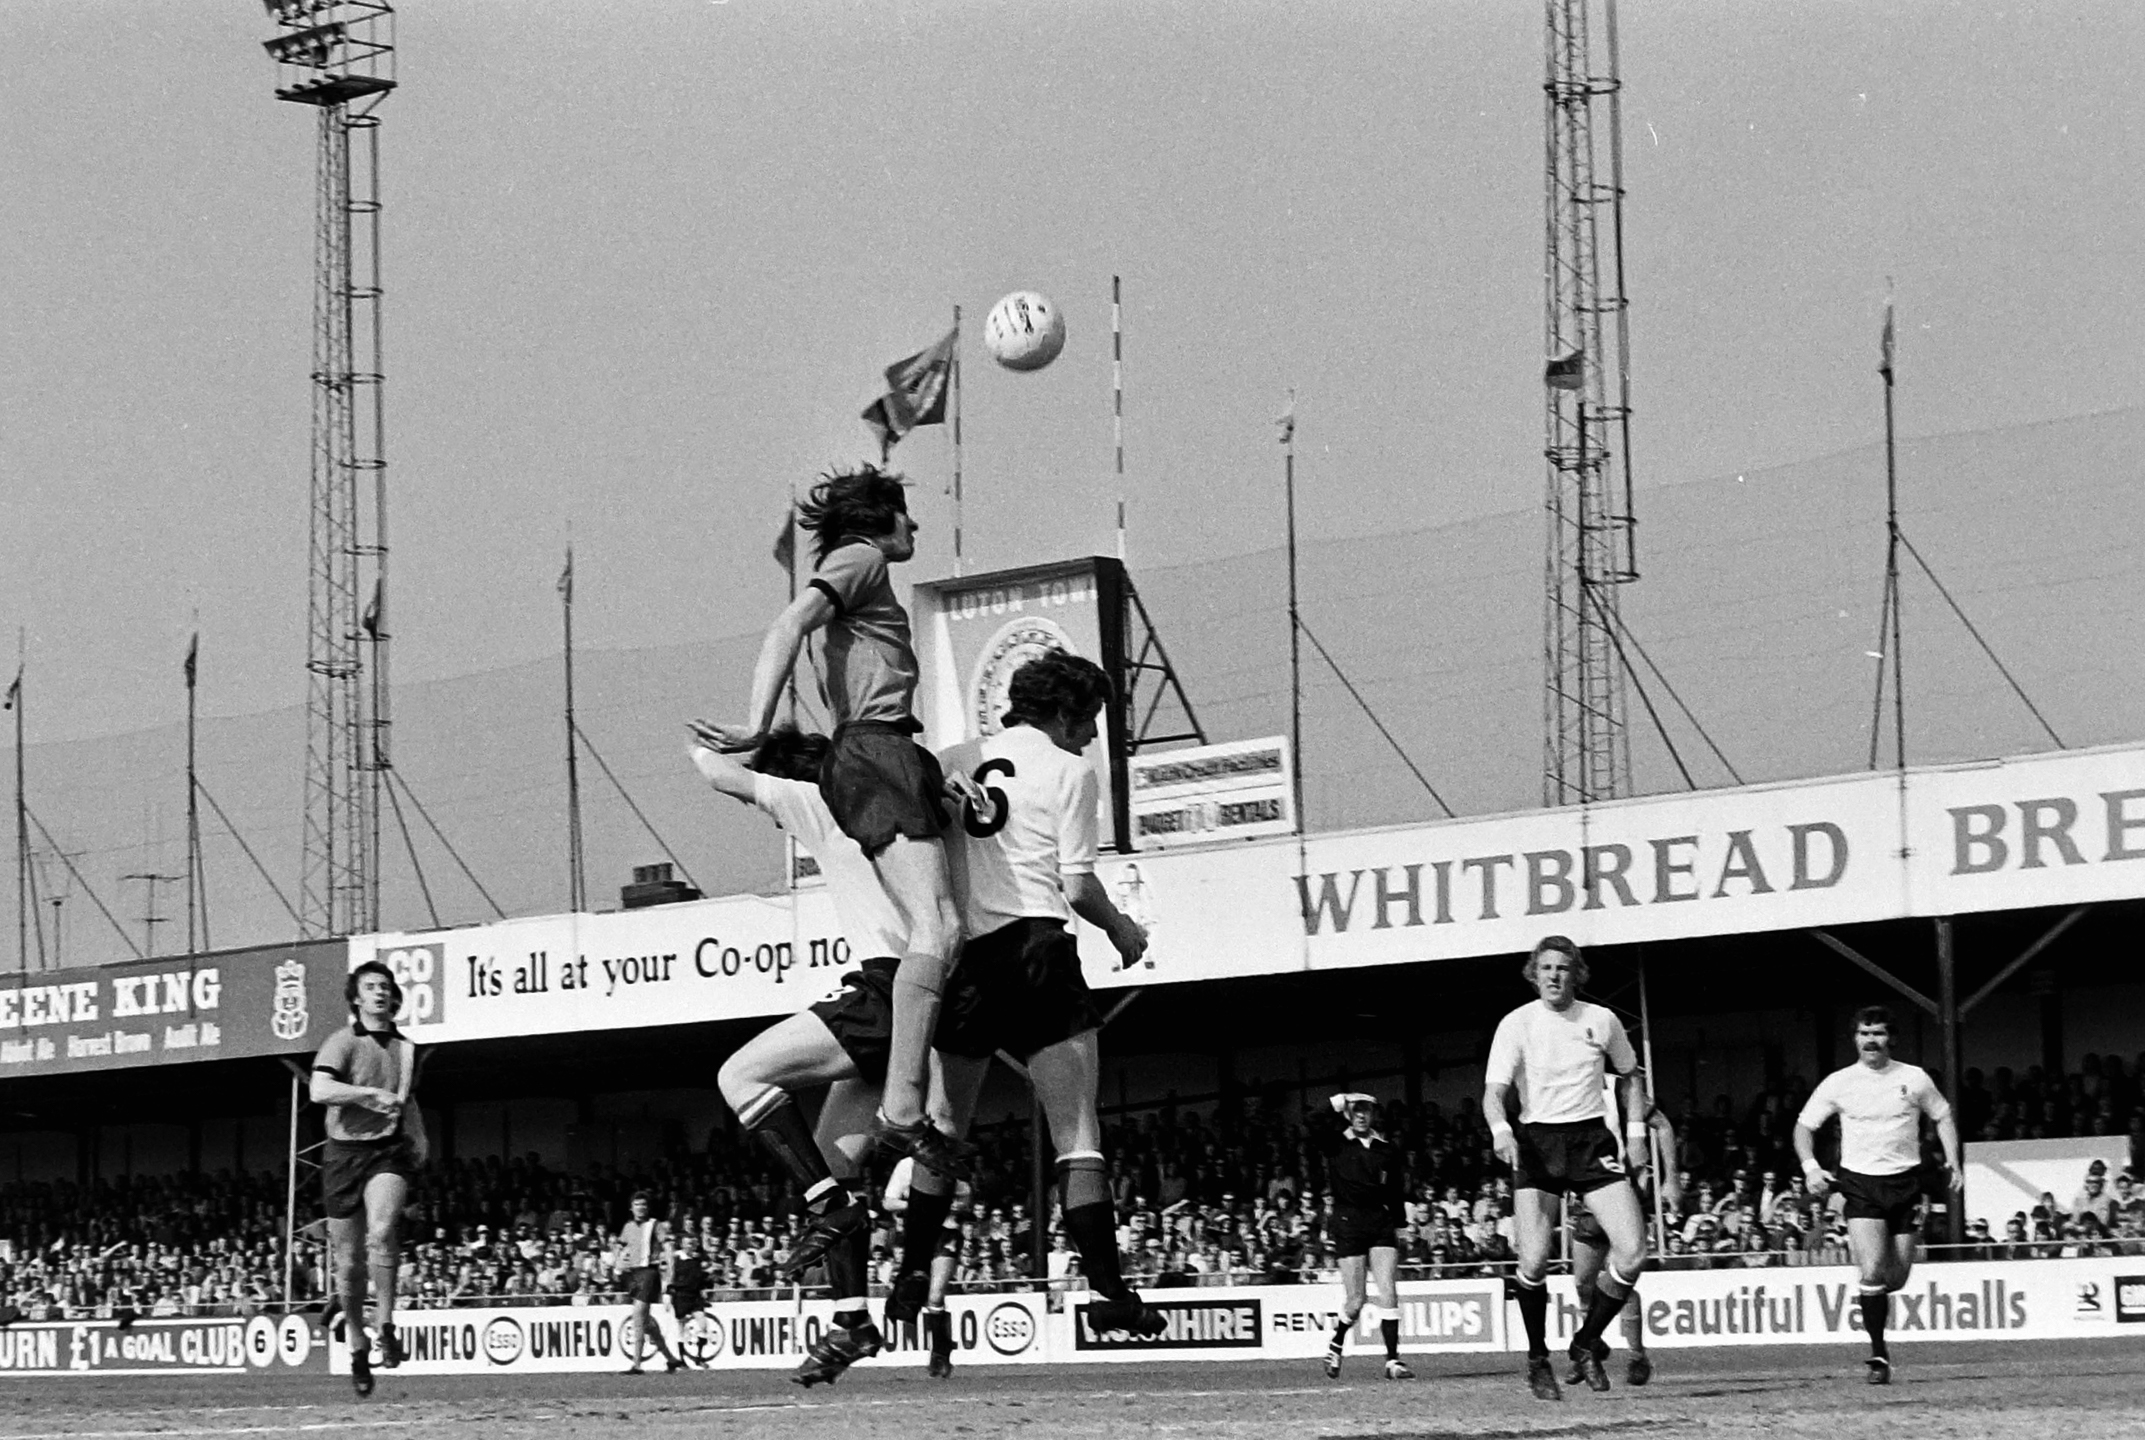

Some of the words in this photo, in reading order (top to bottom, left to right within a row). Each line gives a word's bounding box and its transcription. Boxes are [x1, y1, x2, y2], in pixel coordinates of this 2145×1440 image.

[964, 757, 1015, 838] 6
[1291, 821, 1849, 936] WHITBREAD
[1945, 787, 2145, 876] BRE
[467, 955, 502, 997] It's
[514, 951, 549, 994] all
[561, 954, 588, 990] at
[602, 953, 677, 997] your
[695, 937, 792, 983] Co-op
[112, 968, 221, 1017] KING
[1360, 1300, 1482, 1338] PILIPS
[1647, 1284, 1804, 1336] eautiful
[104, 1337, 119, 1358] A
[122, 1331, 177, 1363] GOAL
[180, 1325, 246, 1366] CLUB
[399, 1324, 477, 1361] UNIFLO
[530, 1320, 611, 1358] UNIFLO
